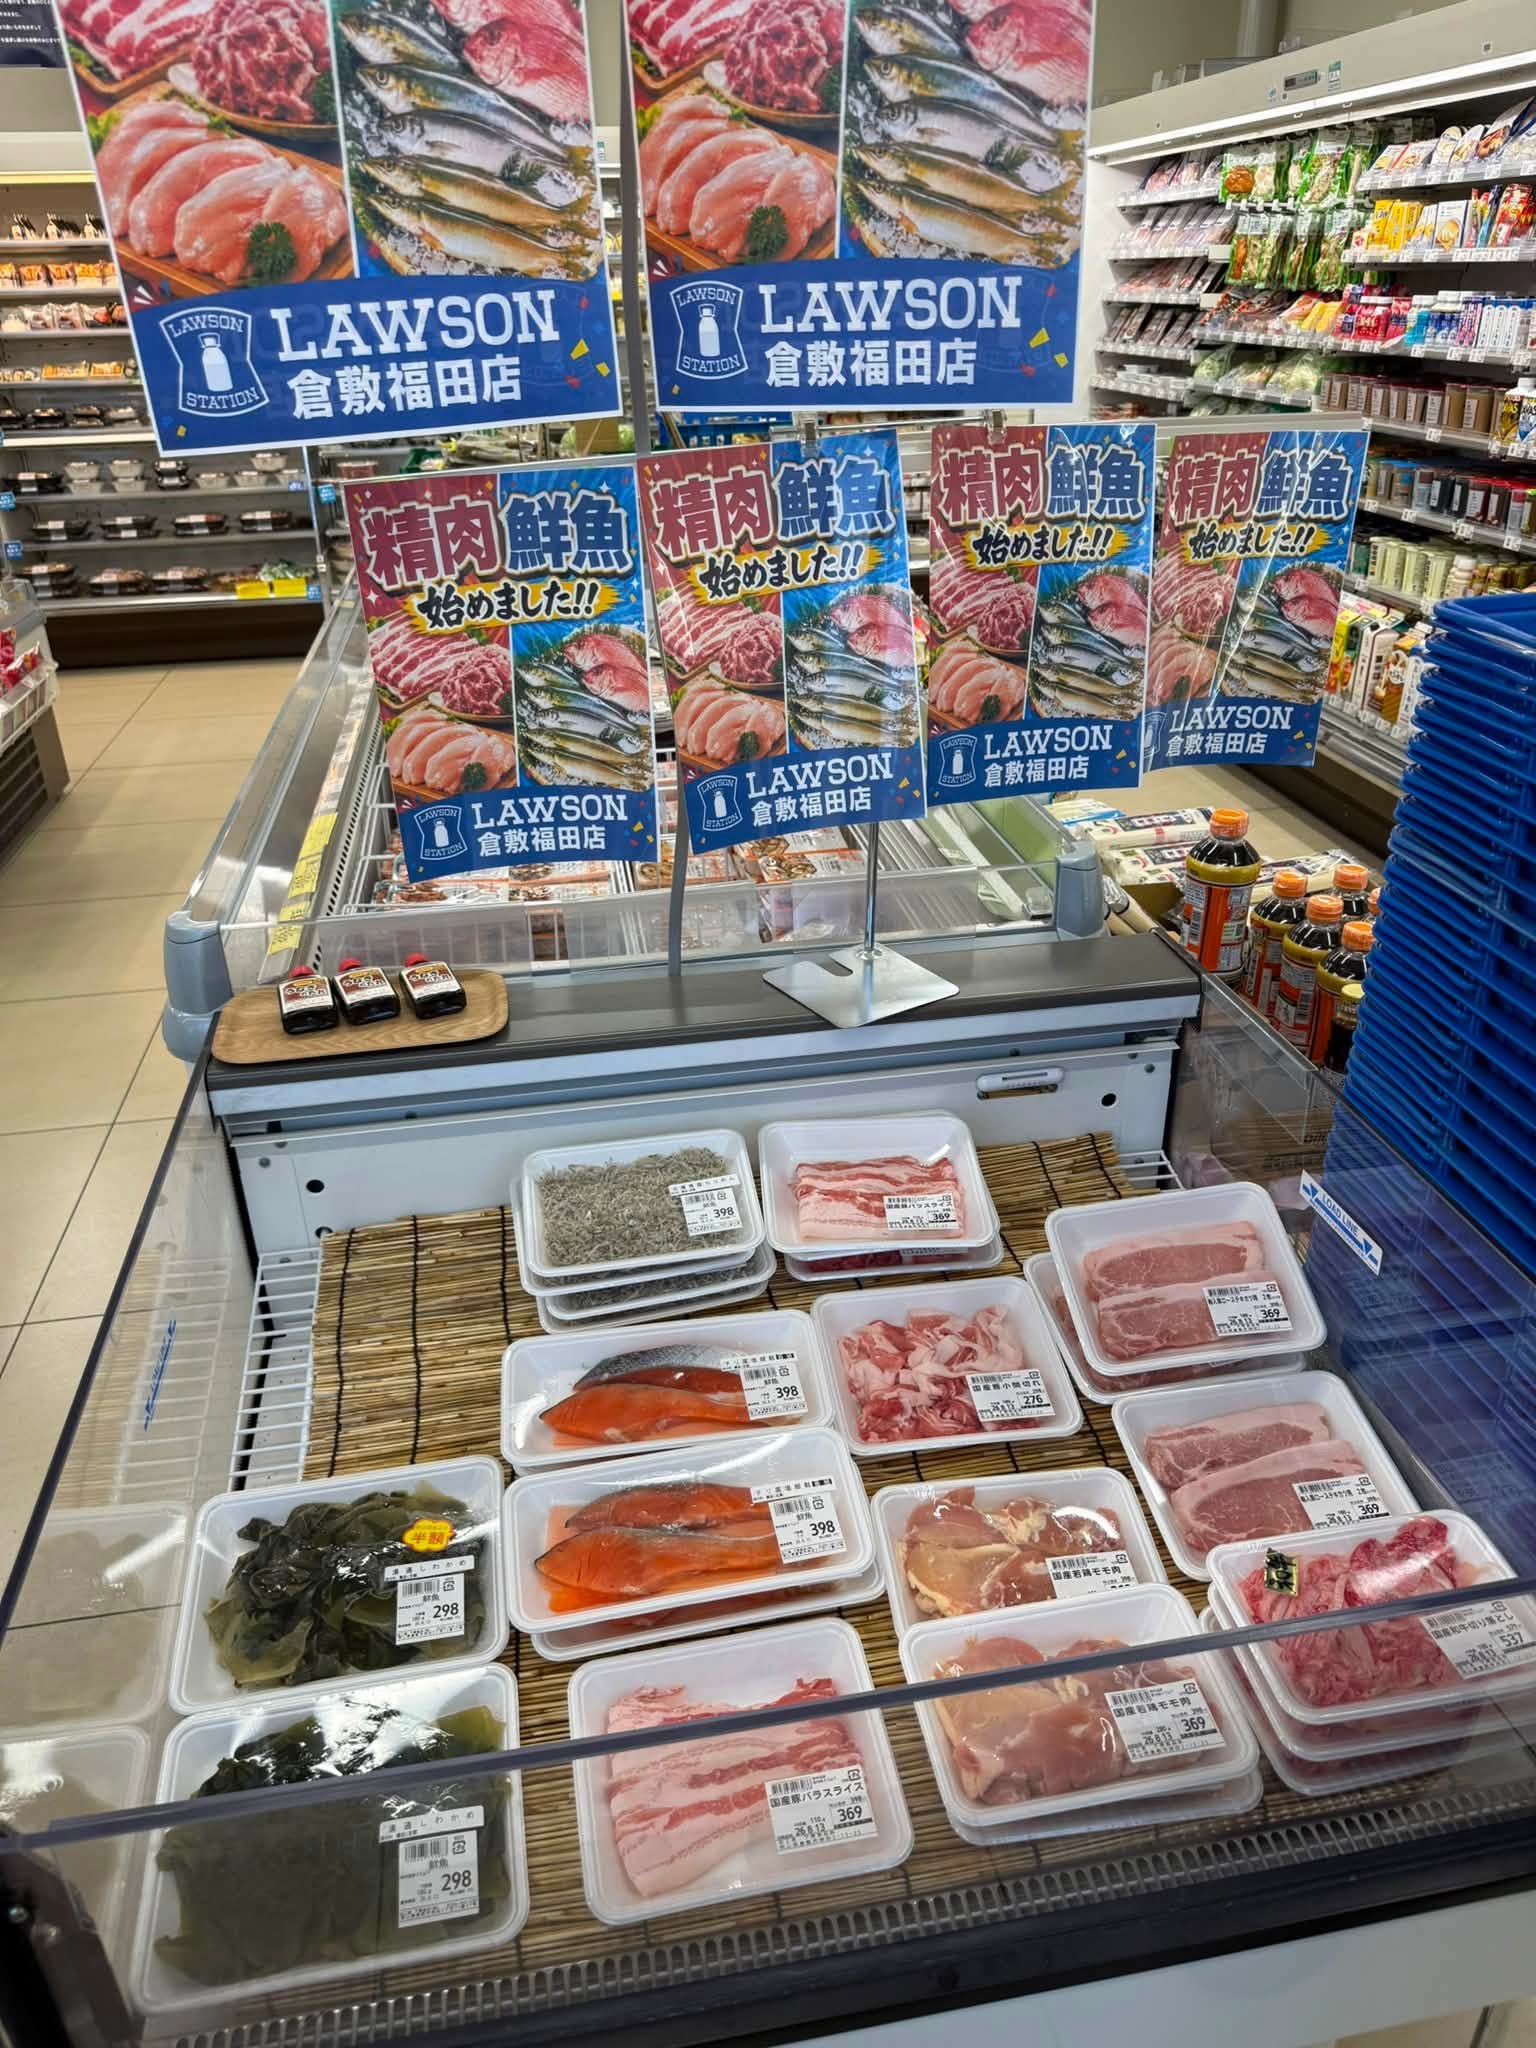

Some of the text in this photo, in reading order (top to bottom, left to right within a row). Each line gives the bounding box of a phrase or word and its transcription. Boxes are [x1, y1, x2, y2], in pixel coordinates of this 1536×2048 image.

[676, 287, 737, 306] LAWSON
[759, 275, 1023, 334] LAWSON
[168, 312, 245, 338] LAWSON
[270, 289, 560, 362] LAWSON
[680, 353, 741, 372] STATION
[764, 337, 978, 388] 倉敷福田店
[185, 386, 261, 410] STATION
[286, 354, 522, 420] 倉敷福田店
[942, 447, 1145, 520] 精肉 鮮魚
[1174, 453, 1255, 524] 精肉
[1255, 451, 1350, 518] 鮮魚
[657, 458, 893, 557] 精肉 鮮魚
[365, 493, 631, 586] 精肉 鮮魚
[1169, 705, 1295, 733] LAWSON
[984, 724, 1114, 760] LAWSON
[1165, 732, 1268, 758] 倉敷福田店
[746, 752, 894, 799] LAWSON
[984, 755, 1090, 788] 倉敷福田店
[700, 778, 735, 793] LAWSON
[417, 807, 459, 822] LAWSON
[472, 794, 628, 830] LAWSON
[751, 786, 872, 827] 倉敷福田店
[704, 814, 742, 830] STATION
[423, 842, 463, 858] STATION
[477, 825, 607, 857] 倉敷福田店
[713, 1206, 735, 1218] 398
[1260, 1308, 1280, 1319] 369
[776, 1385, 799, 1398] 398
[1023, 1394, 1044, 1405] 276
[1358, 1503, 1380, 1515] 369
[809, 1520, 836, 1536] 398
[433, 1602, 459, 1619] 298
[1499, 1631, 1524, 1648] 537
[1113, 1696, 1192, 1718] 国産若鶏モモ肉
[1181, 1716, 1206, 1732] 369
[770, 1782, 864, 1808] 国産豚バラスライス
[837, 1805, 863, 1822] 369
[441, 1870, 472, 1892] 298
